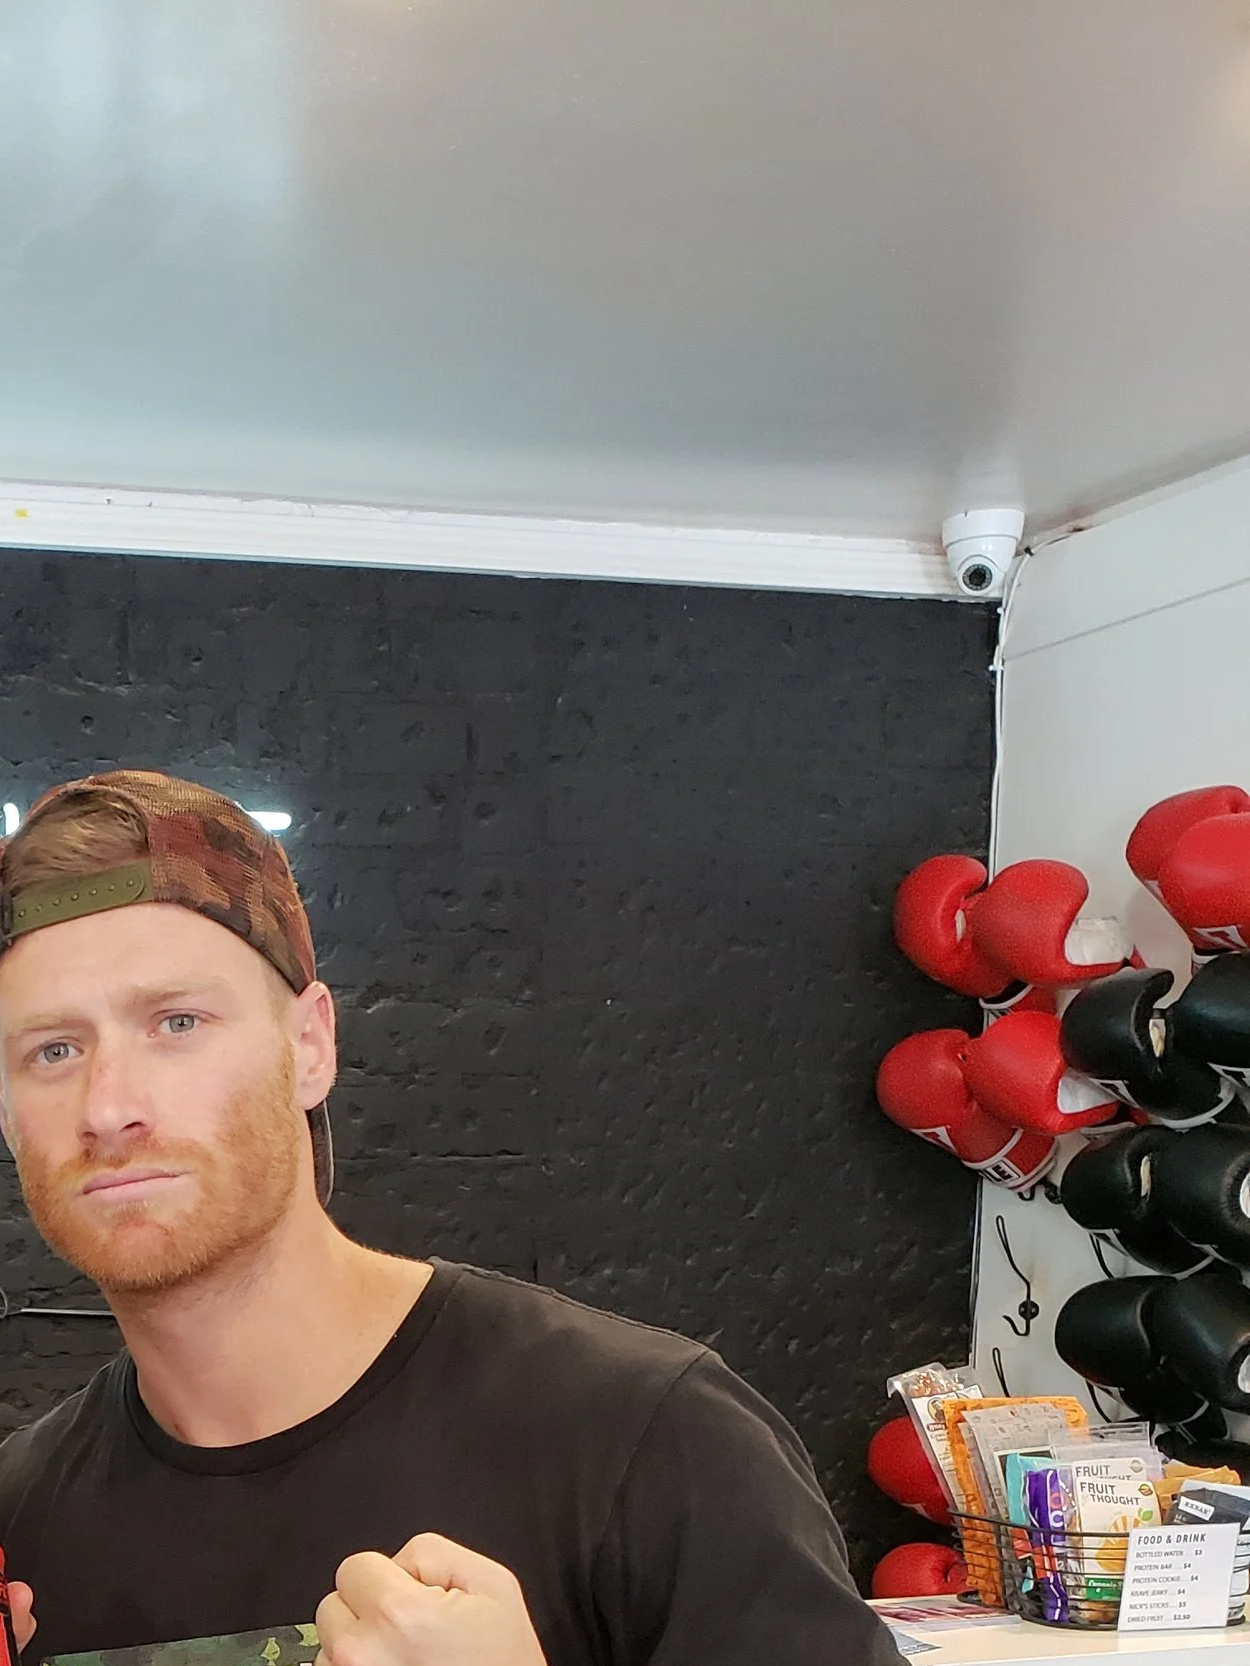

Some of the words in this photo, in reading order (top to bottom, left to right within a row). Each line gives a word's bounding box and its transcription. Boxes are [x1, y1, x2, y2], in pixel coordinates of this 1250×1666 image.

[1075, 1465, 1111, 1478] FRUIT
[1080, 1482, 1116, 1495] FRUIT
[1090, 1493, 1141, 1506] THOUGHT
[1137, 1535, 1163, 1545] FOOD
[1166, 1535, 1171, 1544] &
[1176, 1533, 1207, 1543] DRINK
